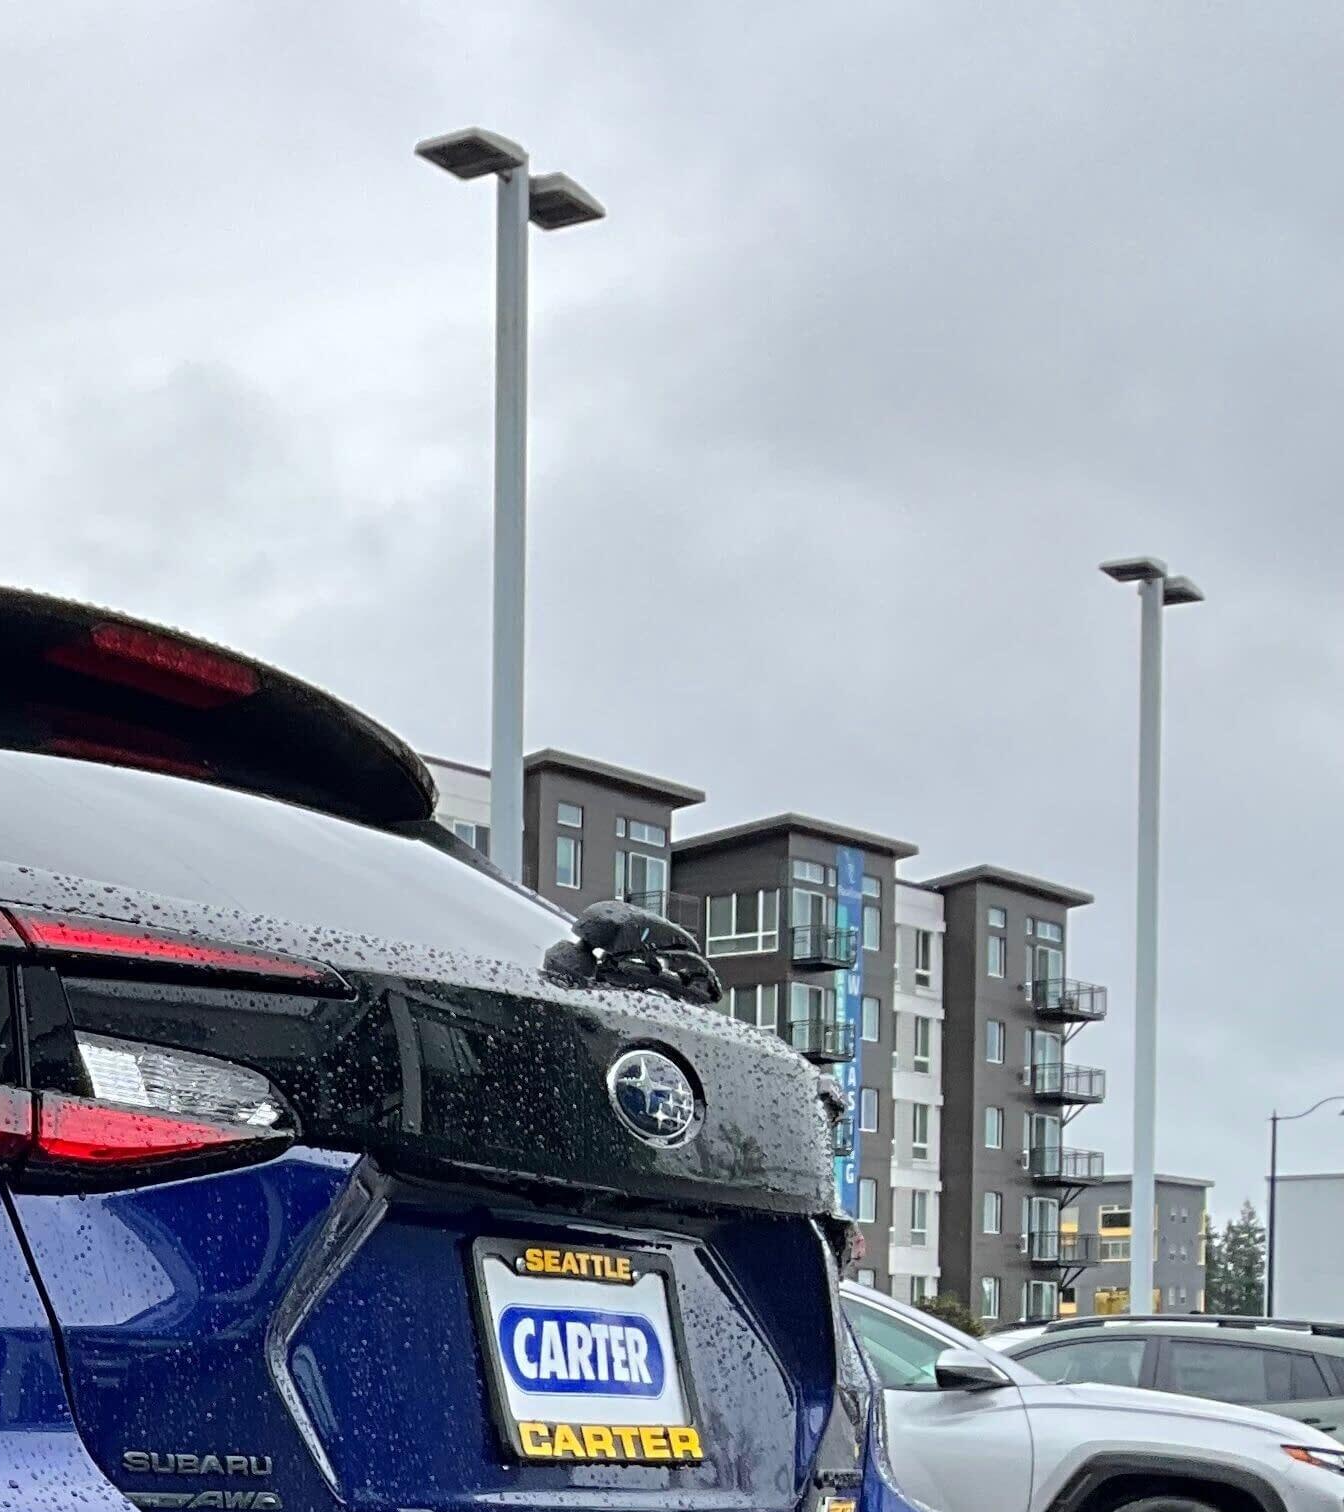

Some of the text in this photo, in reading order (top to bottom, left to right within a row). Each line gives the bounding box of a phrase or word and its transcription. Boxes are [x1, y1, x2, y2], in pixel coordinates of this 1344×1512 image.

[524, 1248, 632, 1280] SEATTLE
[513, 1317, 653, 1384] CARTER
[518, 1421, 704, 1459] CARTER
[123, 1451, 273, 1476] SUBARU
[186, 1490, 283, 1510] AWD
